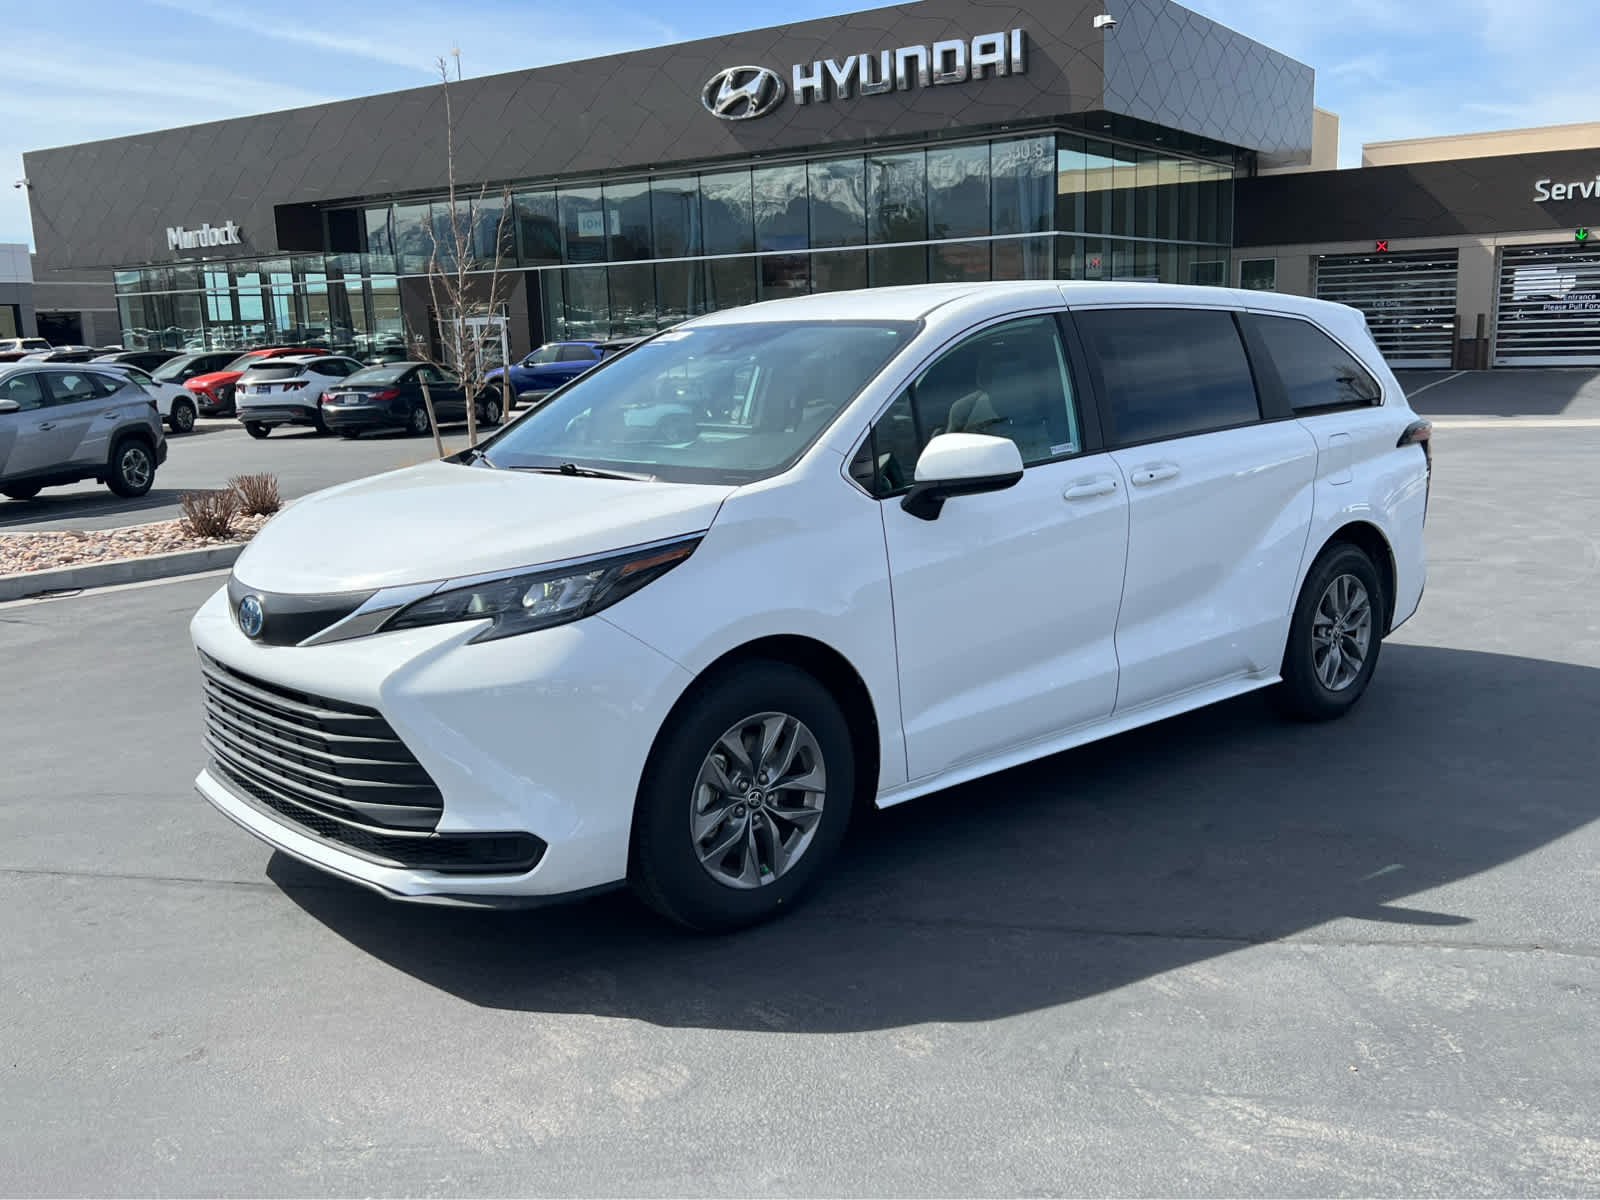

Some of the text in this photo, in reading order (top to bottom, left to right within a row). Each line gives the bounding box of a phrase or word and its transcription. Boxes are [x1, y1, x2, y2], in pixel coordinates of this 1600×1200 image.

[792, 28, 1025, 105] HYUNDAI
[166, 220, 242, 250] Murdock
[1543, 303, 1567, 311] Please
